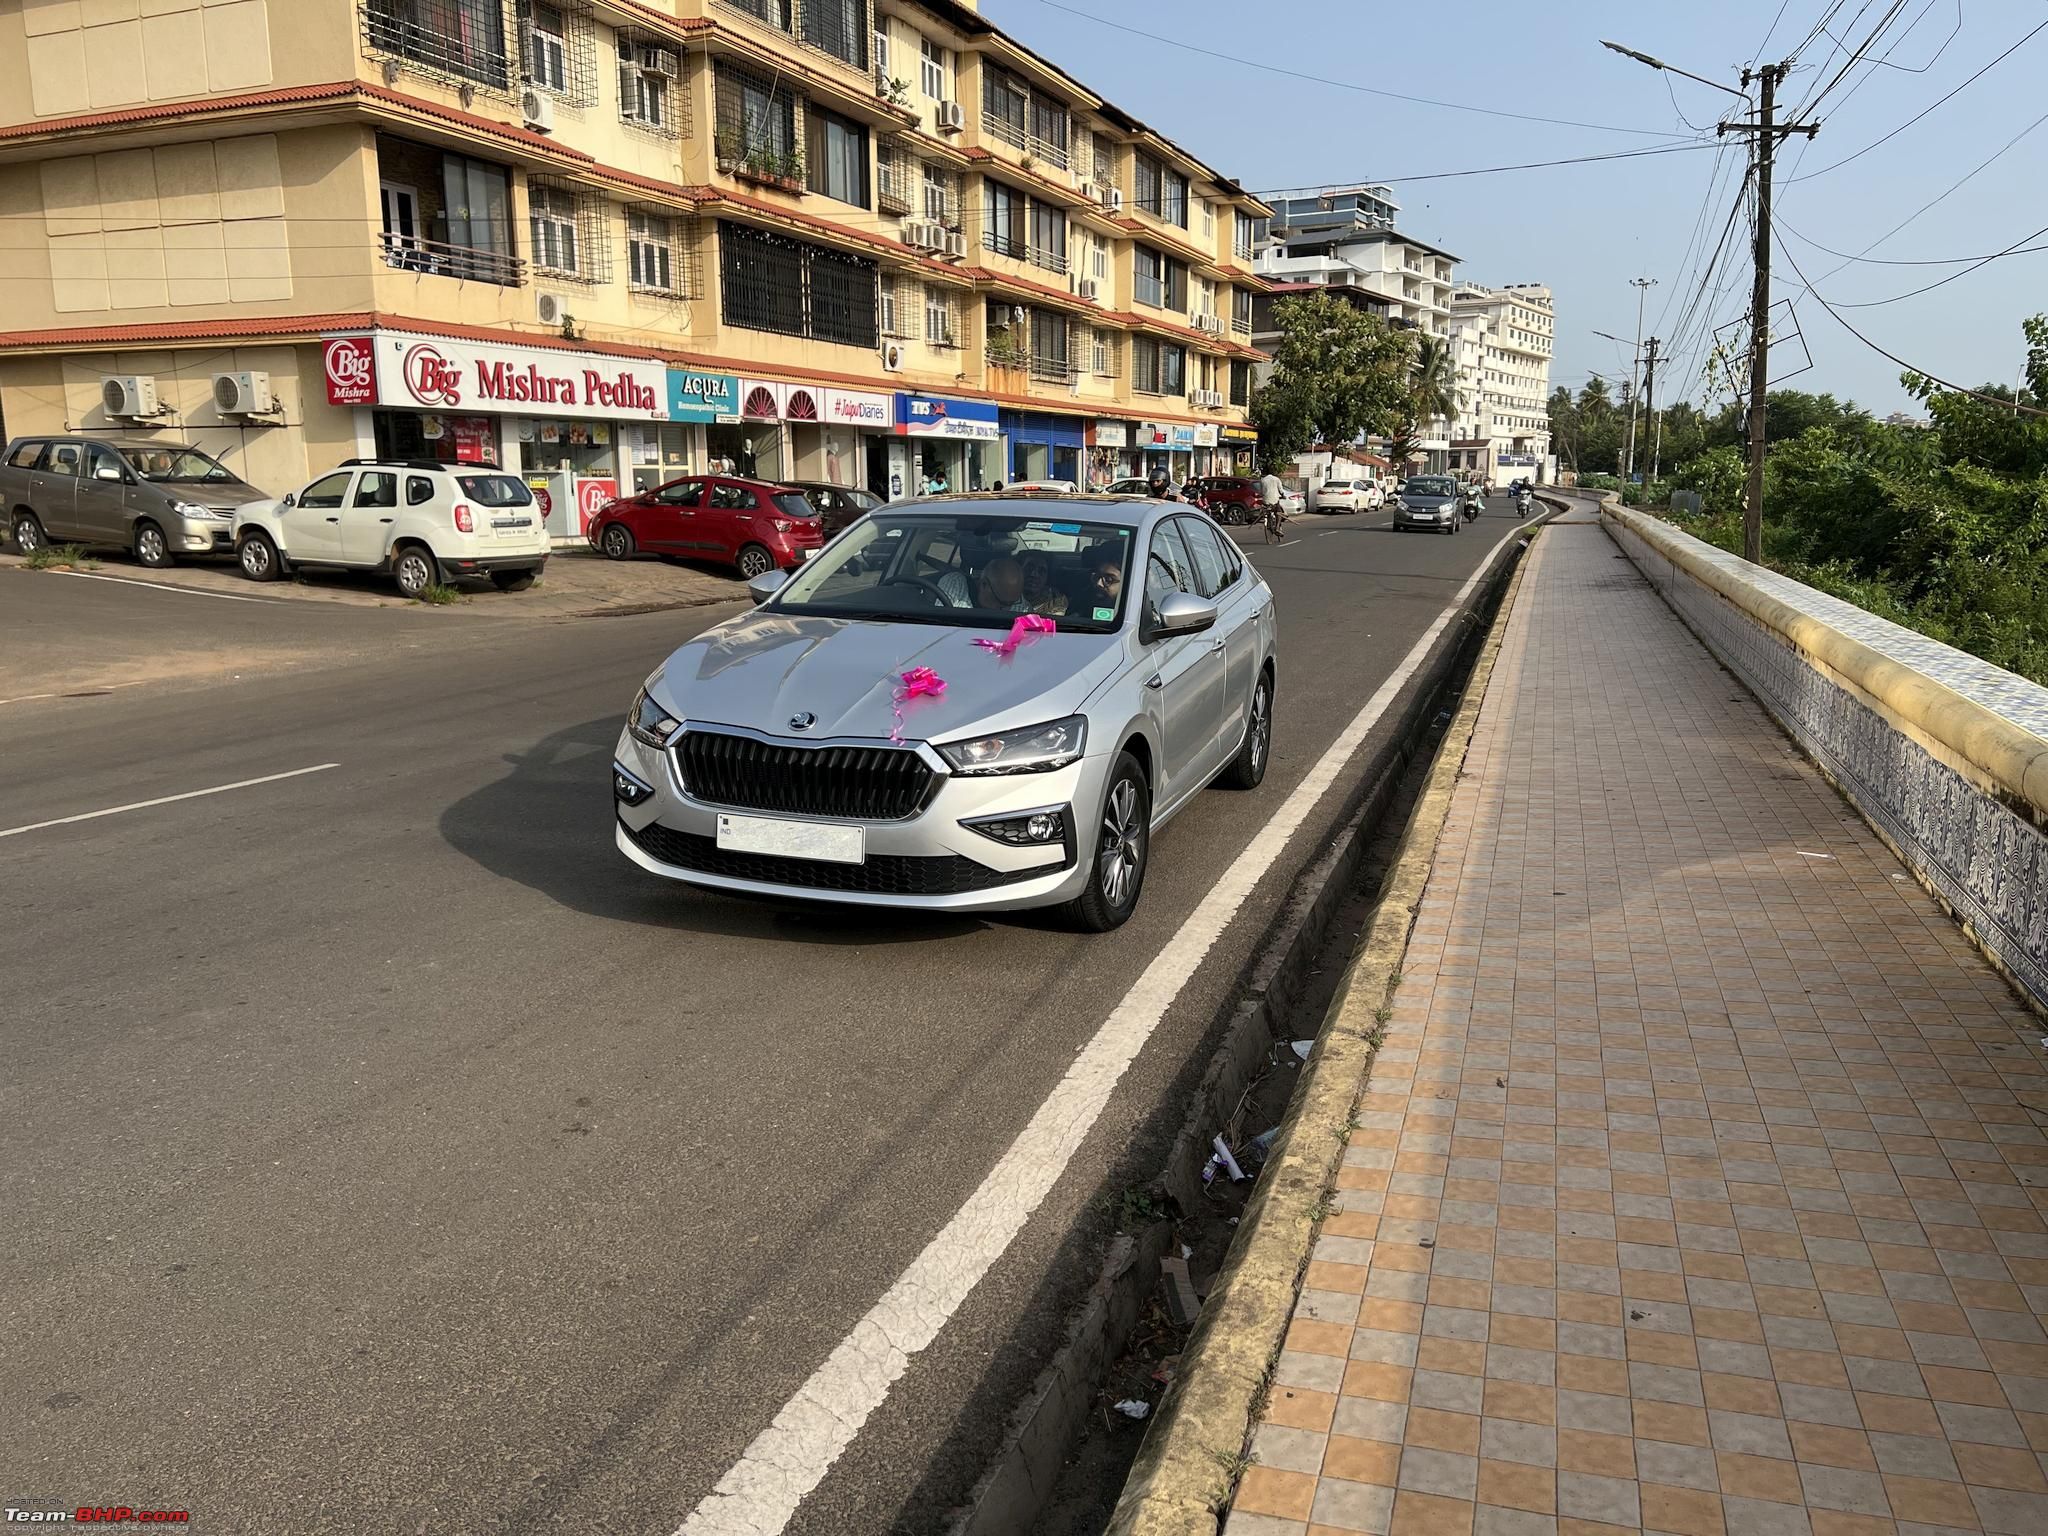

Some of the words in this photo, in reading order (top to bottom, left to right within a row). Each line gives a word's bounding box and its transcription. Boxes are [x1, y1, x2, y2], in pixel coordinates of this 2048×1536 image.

[337, 349, 371, 385] Big
[334, 387, 370, 398] Mishra
[418, 357, 462, 406] Big
[475, 360, 577, 405] Mishra
[583, 370, 656, 410] Pedha
[682, 375, 729, 404] ACURA
